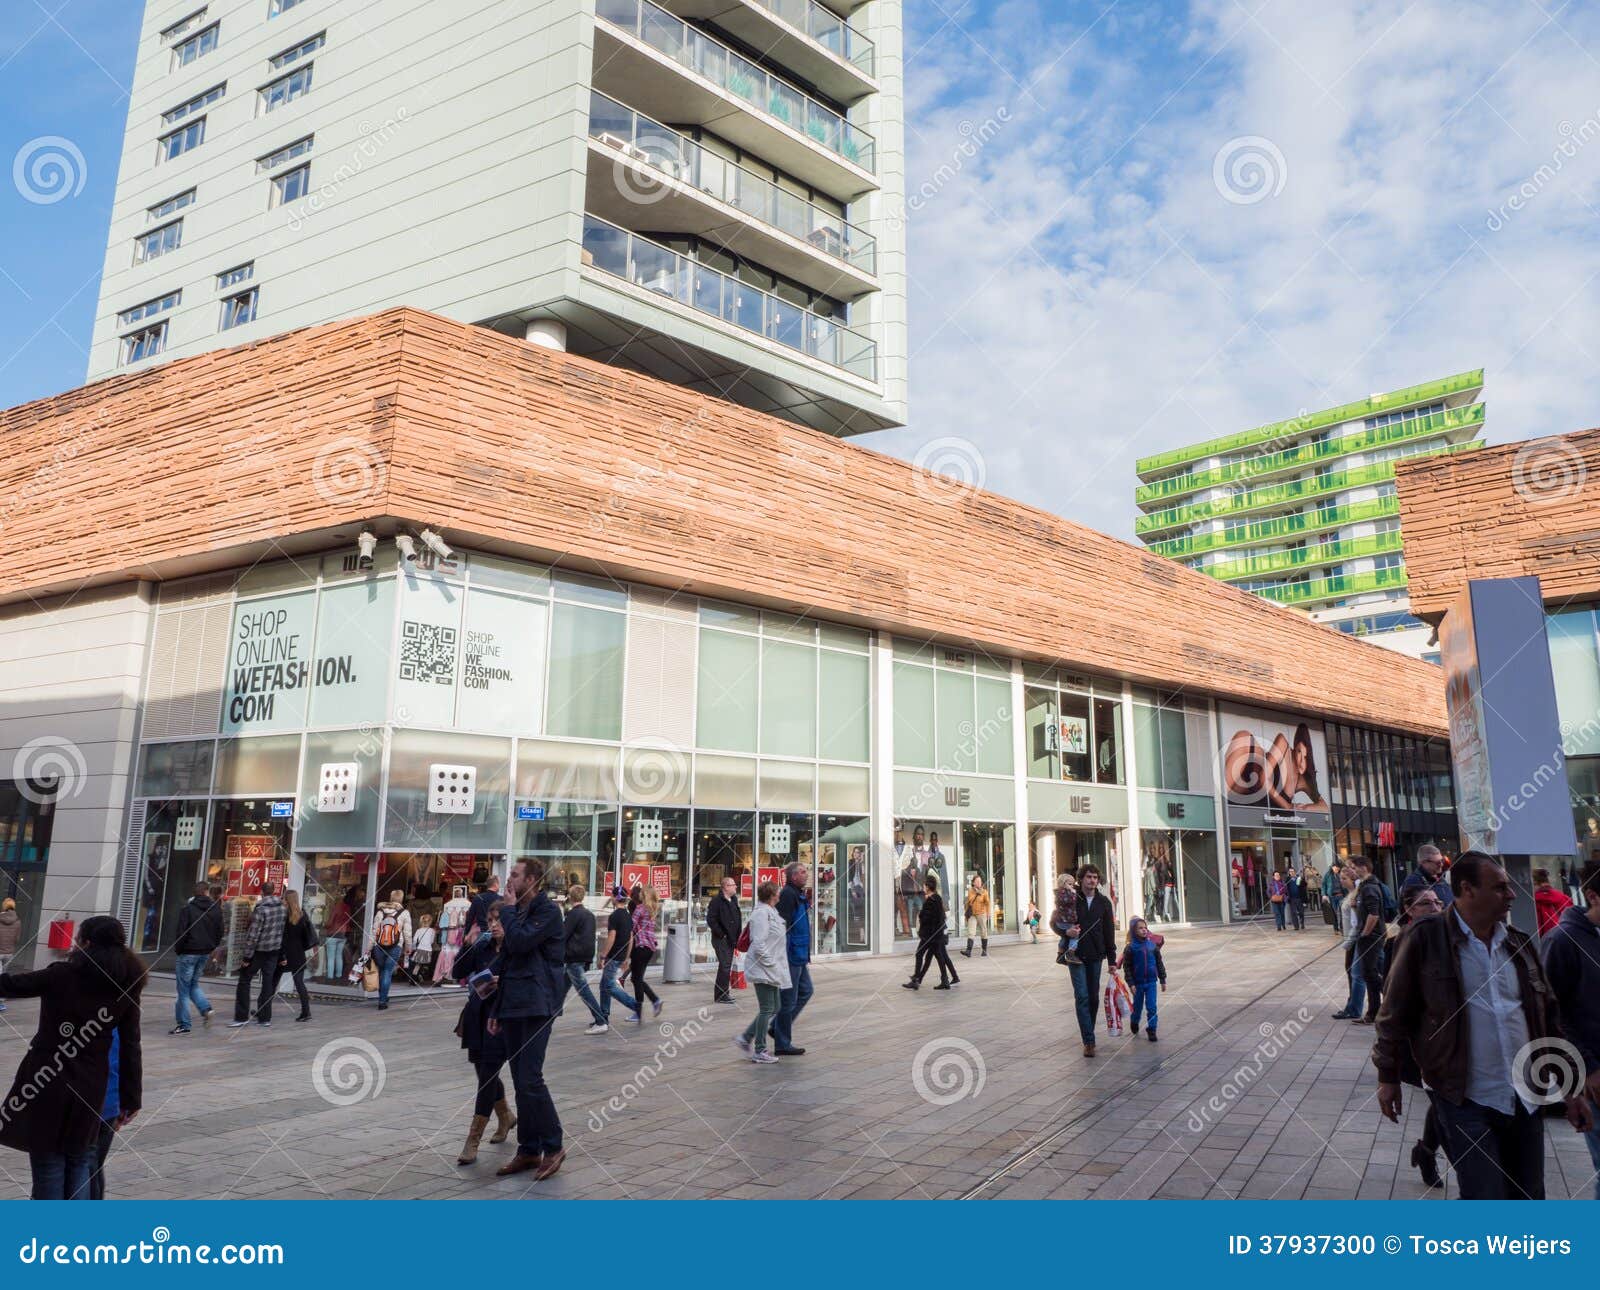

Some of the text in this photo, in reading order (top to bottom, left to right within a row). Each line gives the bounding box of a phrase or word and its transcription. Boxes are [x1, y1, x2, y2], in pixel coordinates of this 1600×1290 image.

[239, 609, 287, 639] SHOP
[467, 631, 494, 644] SHOP
[236, 634, 300, 666] ONLINE
[466, 643, 501, 657] ONLINE
[465, 653, 482, 665] WE
[464, 665, 513, 681] FASHION.
[464, 676, 489, 690] COM
[229, 693, 275, 724] COM
[323, 797, 346, 806] SIX
[437, 798, 467, 807] SIX
[944, 786, 970, 807] WE
[1069, 795, 1091, 814] WE
[1167, 801, 1185, 819] WE
